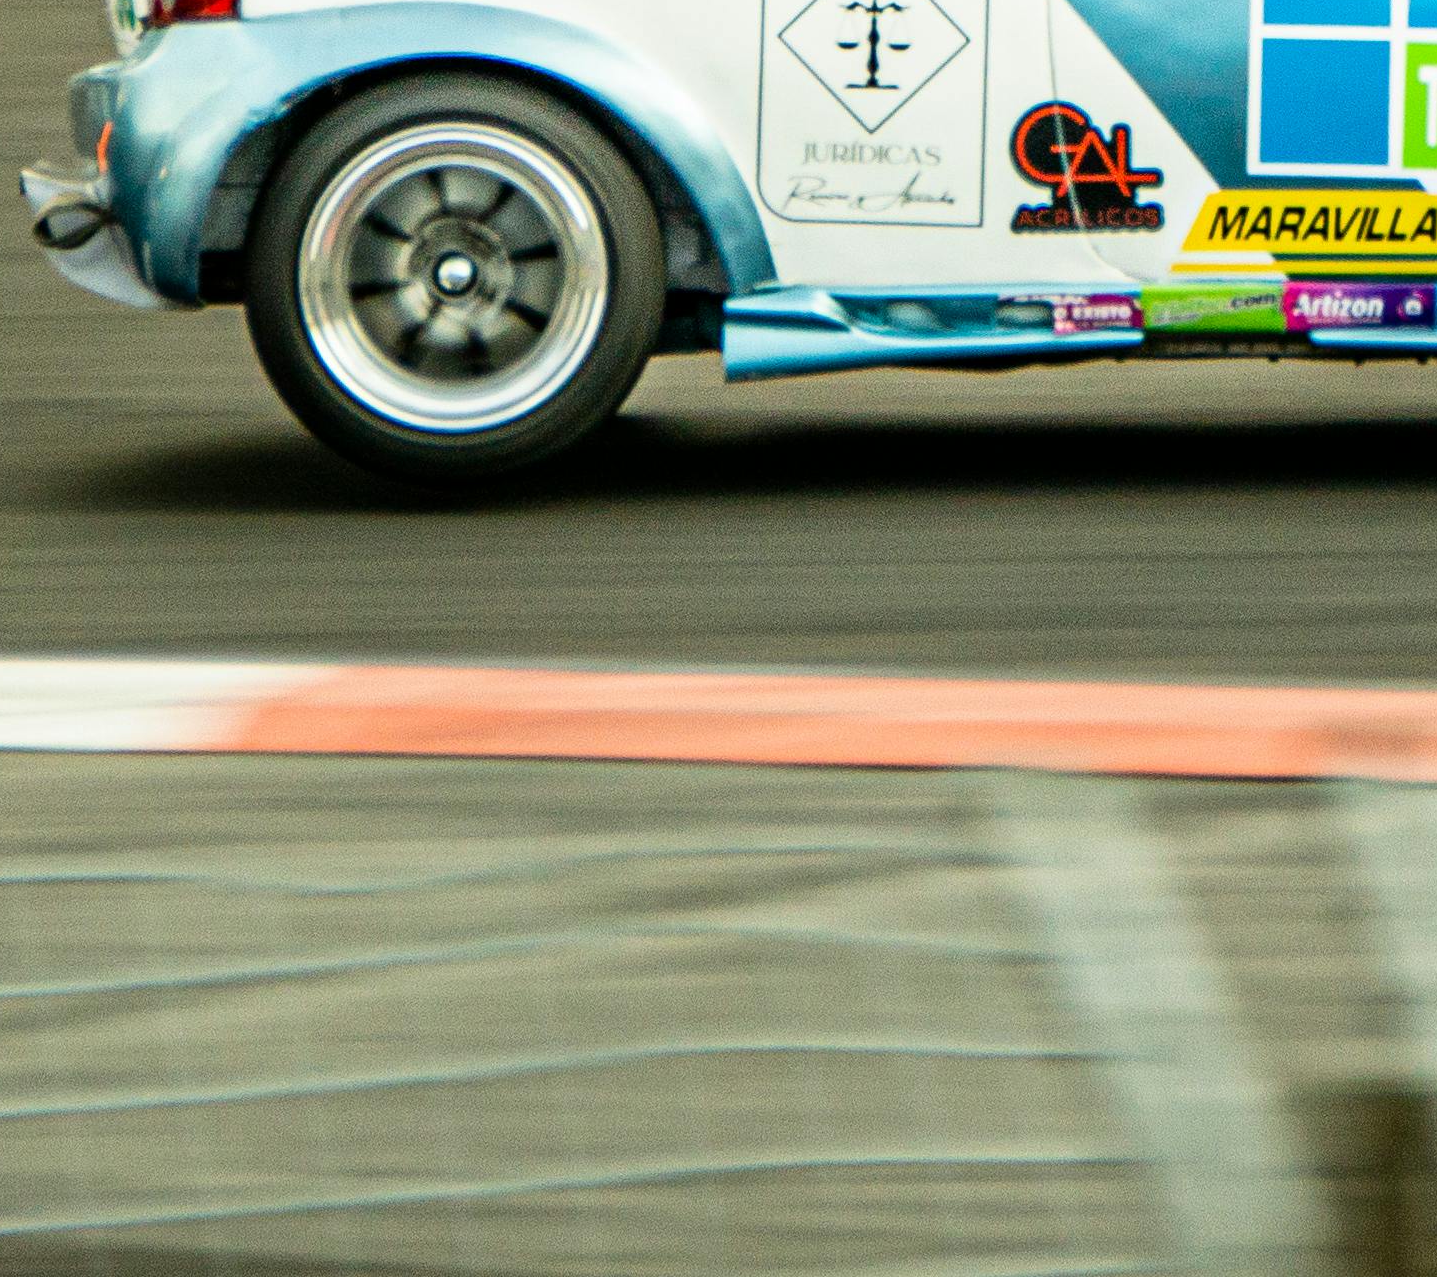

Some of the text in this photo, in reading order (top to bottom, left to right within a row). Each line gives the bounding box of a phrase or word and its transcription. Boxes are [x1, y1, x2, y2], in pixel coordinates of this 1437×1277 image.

[802, 139, 941, 166] JURÍDICAS
[1208, 206, 1437, 242] MARAVILLA
[1295, 292, 1383, 317] Artizon
